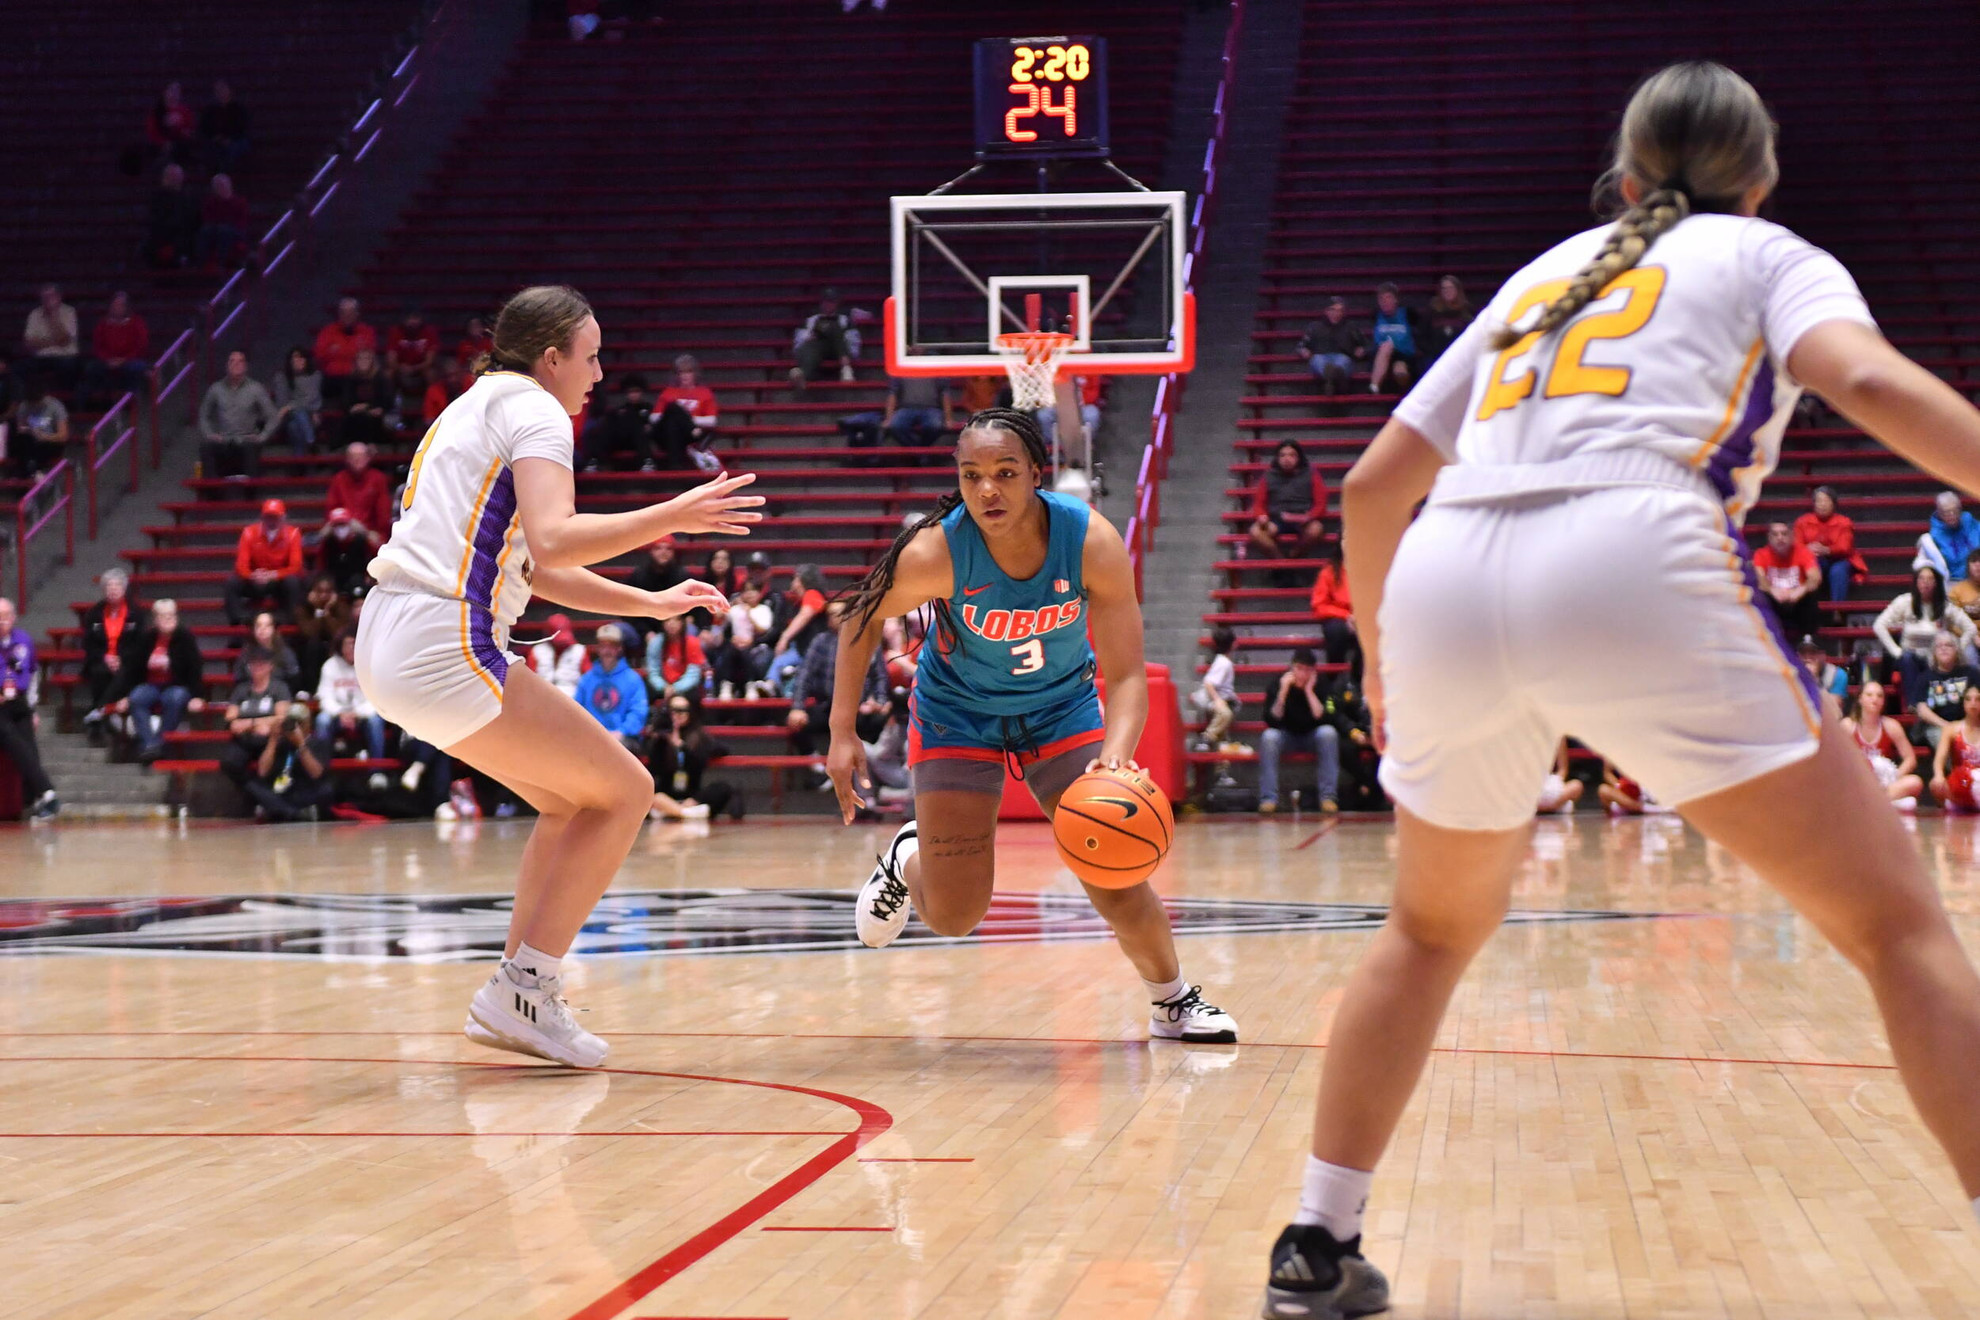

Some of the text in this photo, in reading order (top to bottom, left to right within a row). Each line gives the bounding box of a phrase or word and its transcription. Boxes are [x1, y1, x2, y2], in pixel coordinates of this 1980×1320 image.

[1011, 45, 1090, 82] 2:20
[1005, 83, 1076, 142] 24
[1476, 264, 1667, 422] 22
[962, 595, 1082, 641] LOBOS
[1010, 638, 1045, 675] 3
